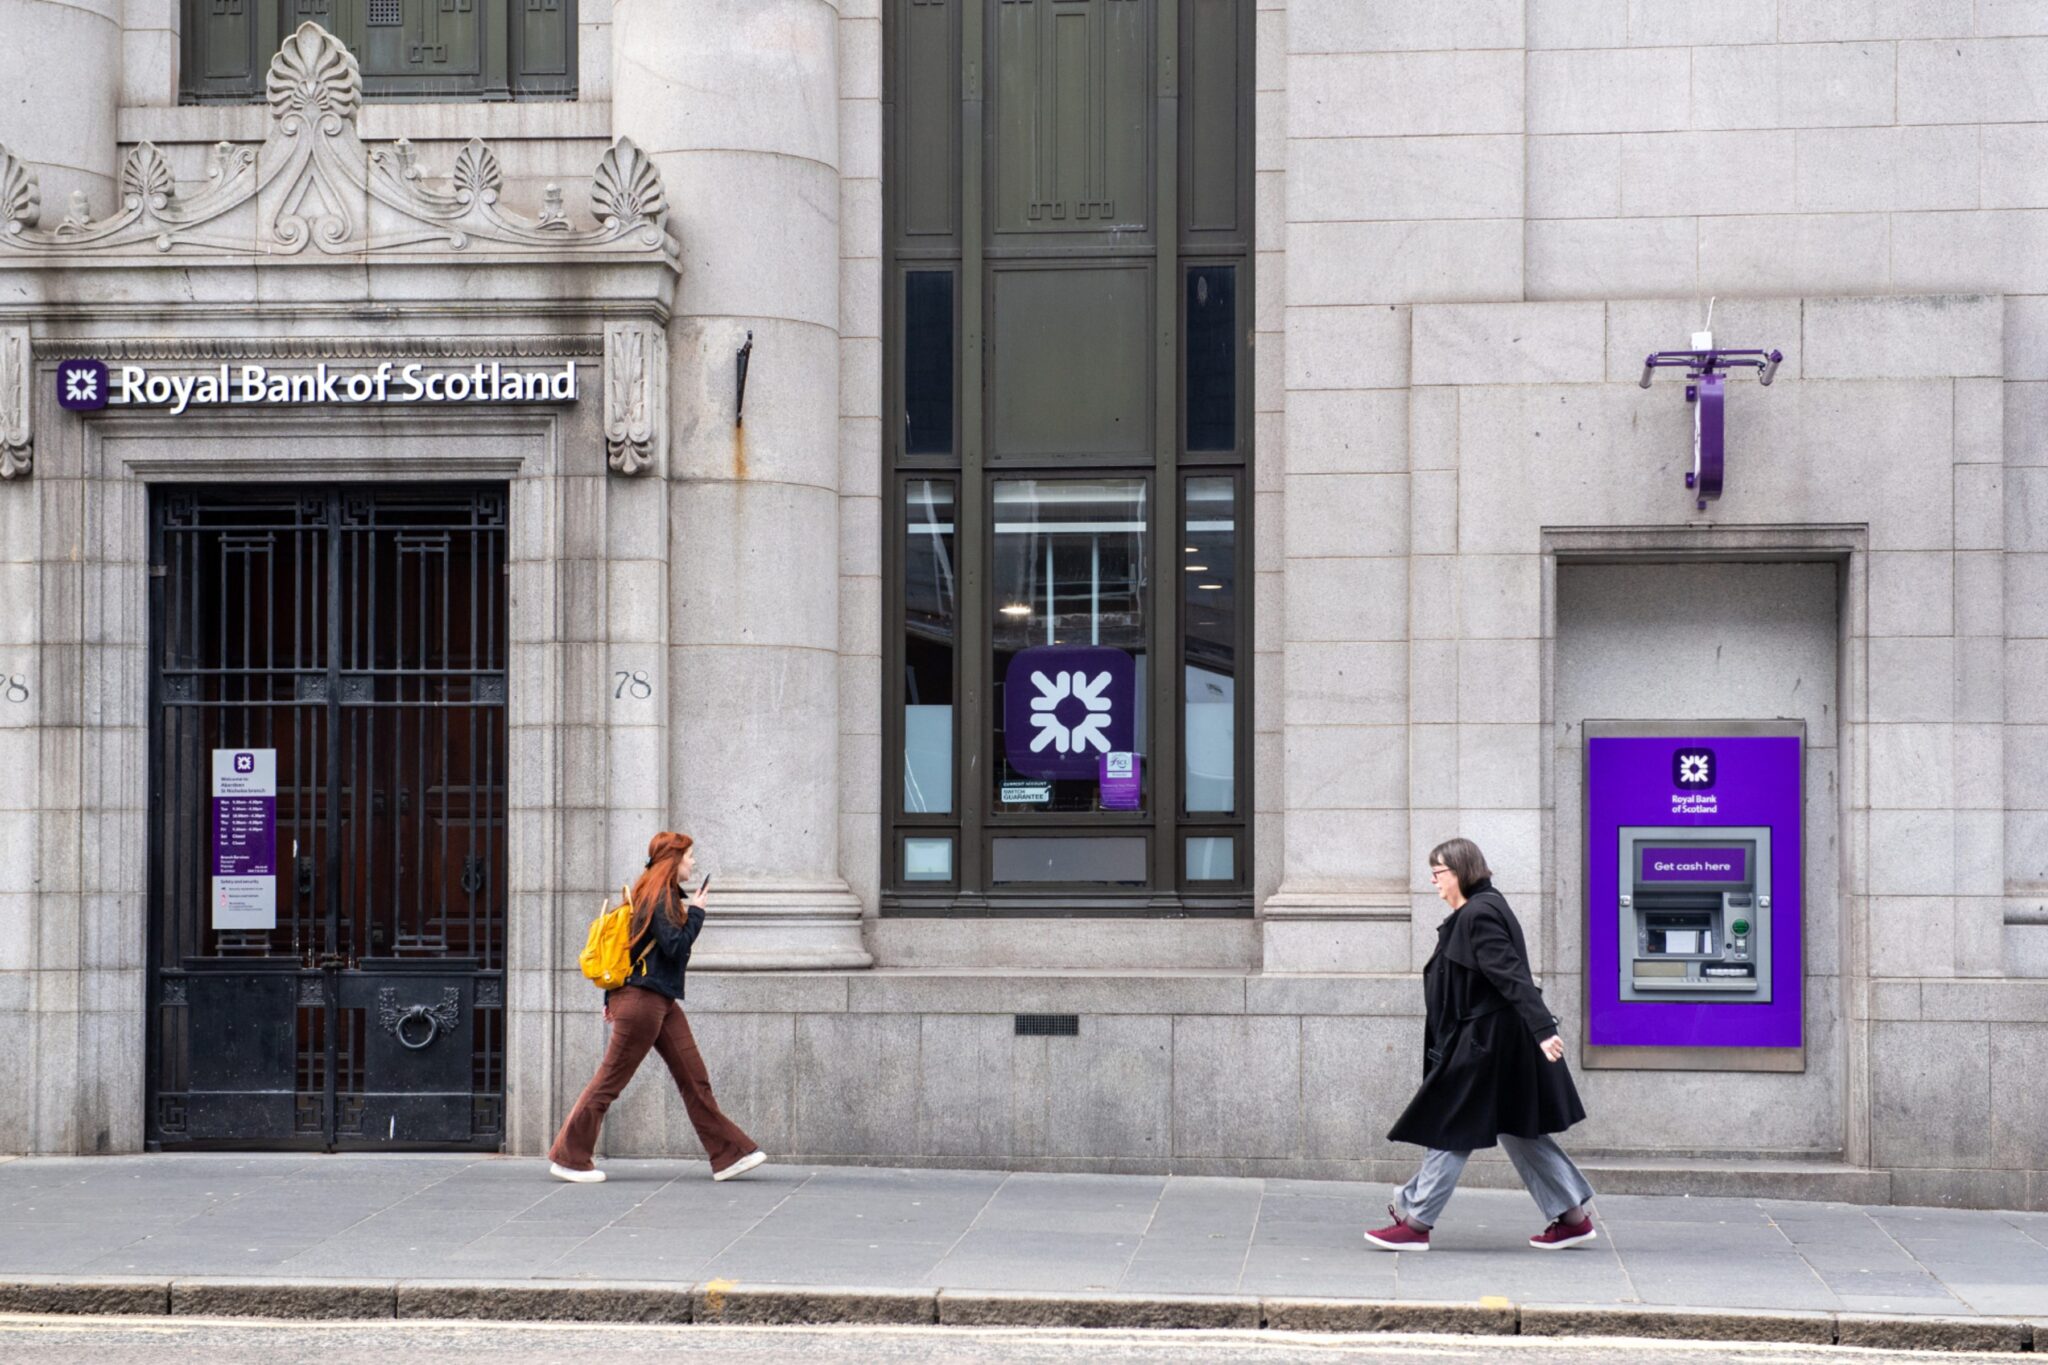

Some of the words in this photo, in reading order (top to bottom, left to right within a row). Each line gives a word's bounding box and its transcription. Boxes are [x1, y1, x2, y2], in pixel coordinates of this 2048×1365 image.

[122, 364, 229, 414] Royal
[242, 364, 339, 402] Bank
[347, 362, 392, 401] of
[402, 361, 577, 400] Scotland
[615, 671, 651, 699] 78
[1672, 795, 1695, 804] Royal
[1695, 795, 1717, 803] Bank
[1672, 805, 1681, 813] of
[1682, 805, 1718, 813] Scotland
[1654, 862, 1675, 871] Get
[1676, 862, 1703, 871] cash
[1705, 862, 1731, 871] here
